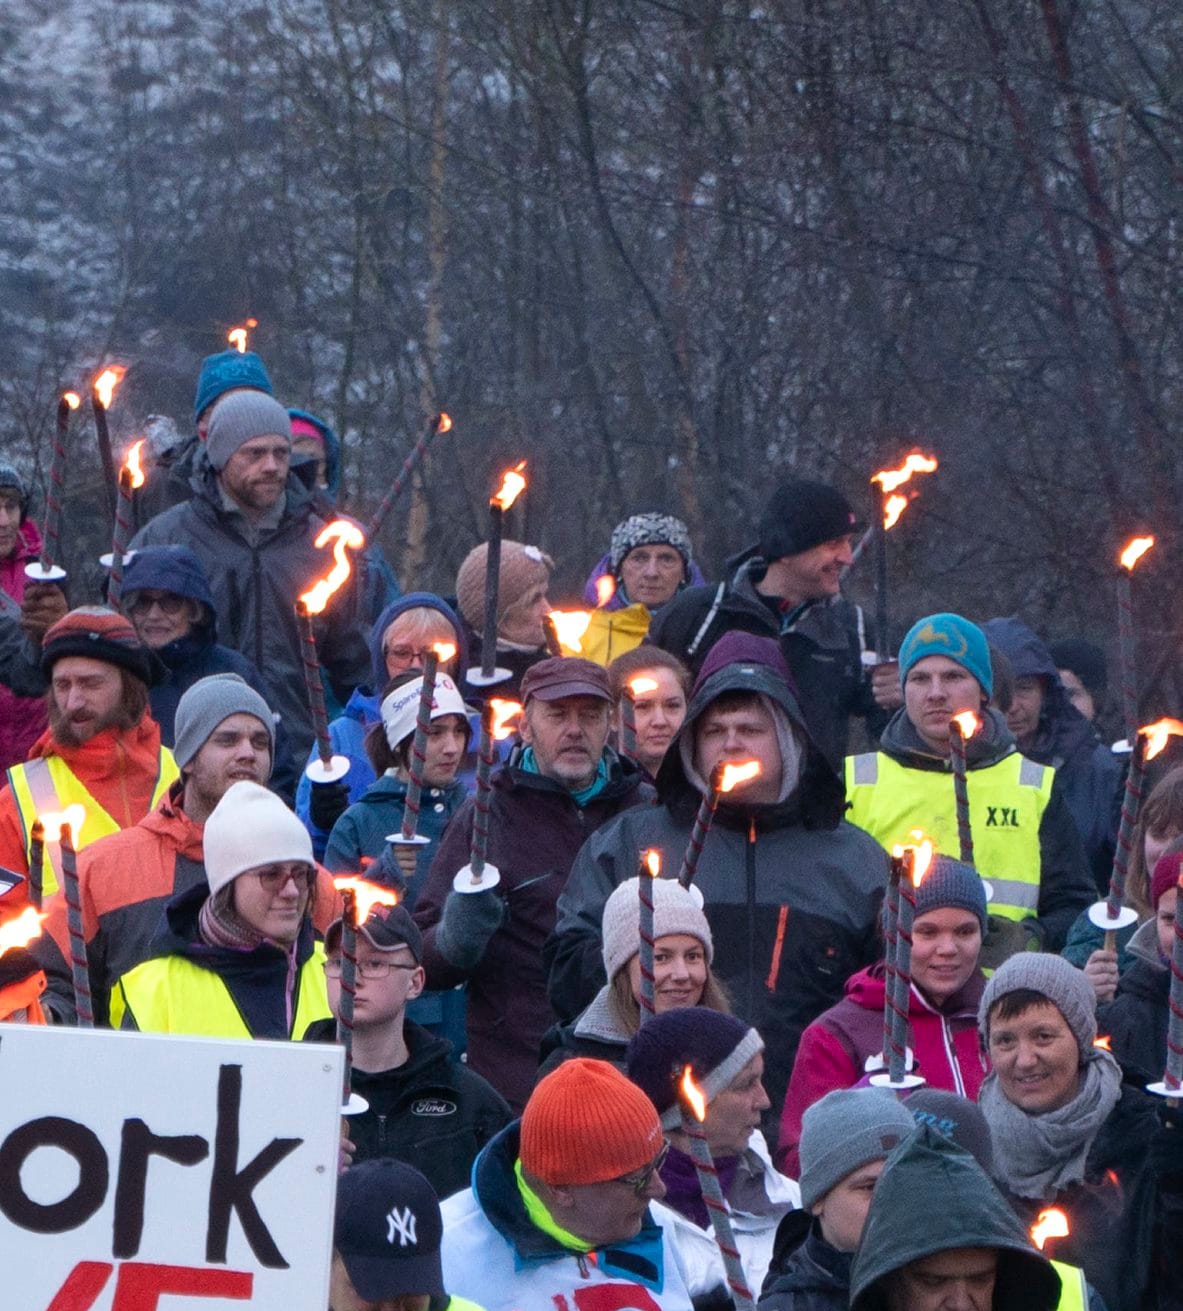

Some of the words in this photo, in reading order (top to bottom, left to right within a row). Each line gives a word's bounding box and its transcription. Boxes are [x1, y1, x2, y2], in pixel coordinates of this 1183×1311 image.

[986, 806, 1019, 828] XXL
[415, 1100, 449, 1114] Ford
[386, 1206, 417, 1247] NY
